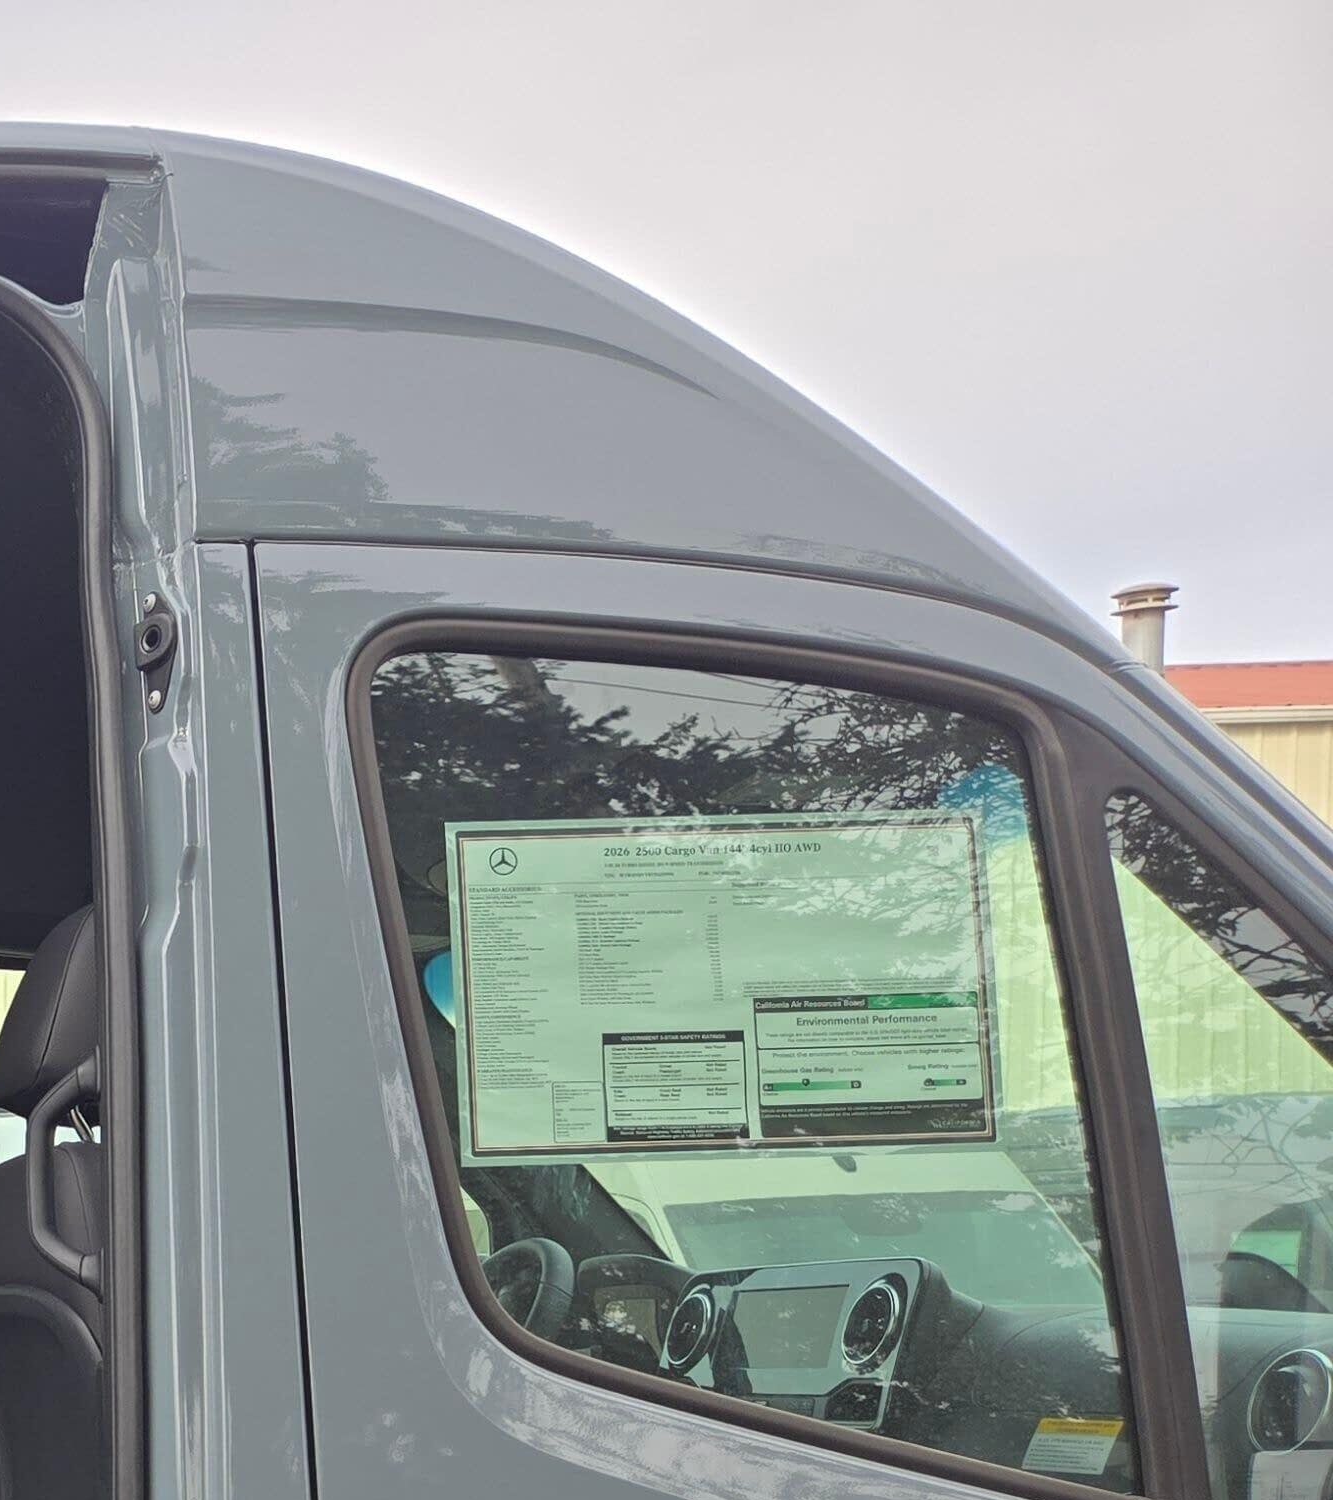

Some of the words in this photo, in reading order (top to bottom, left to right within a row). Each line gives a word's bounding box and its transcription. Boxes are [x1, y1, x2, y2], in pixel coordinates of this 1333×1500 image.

[604, 847, 630, 857] 2026
[635, 846, 662, 856] 2500
[664, 846, 696, 858] Cargo
[794, 842, 822, 853] AWD
[796, 1016, 869, 1027] Environmental
[871, 1014, 937, 1025] Performance
